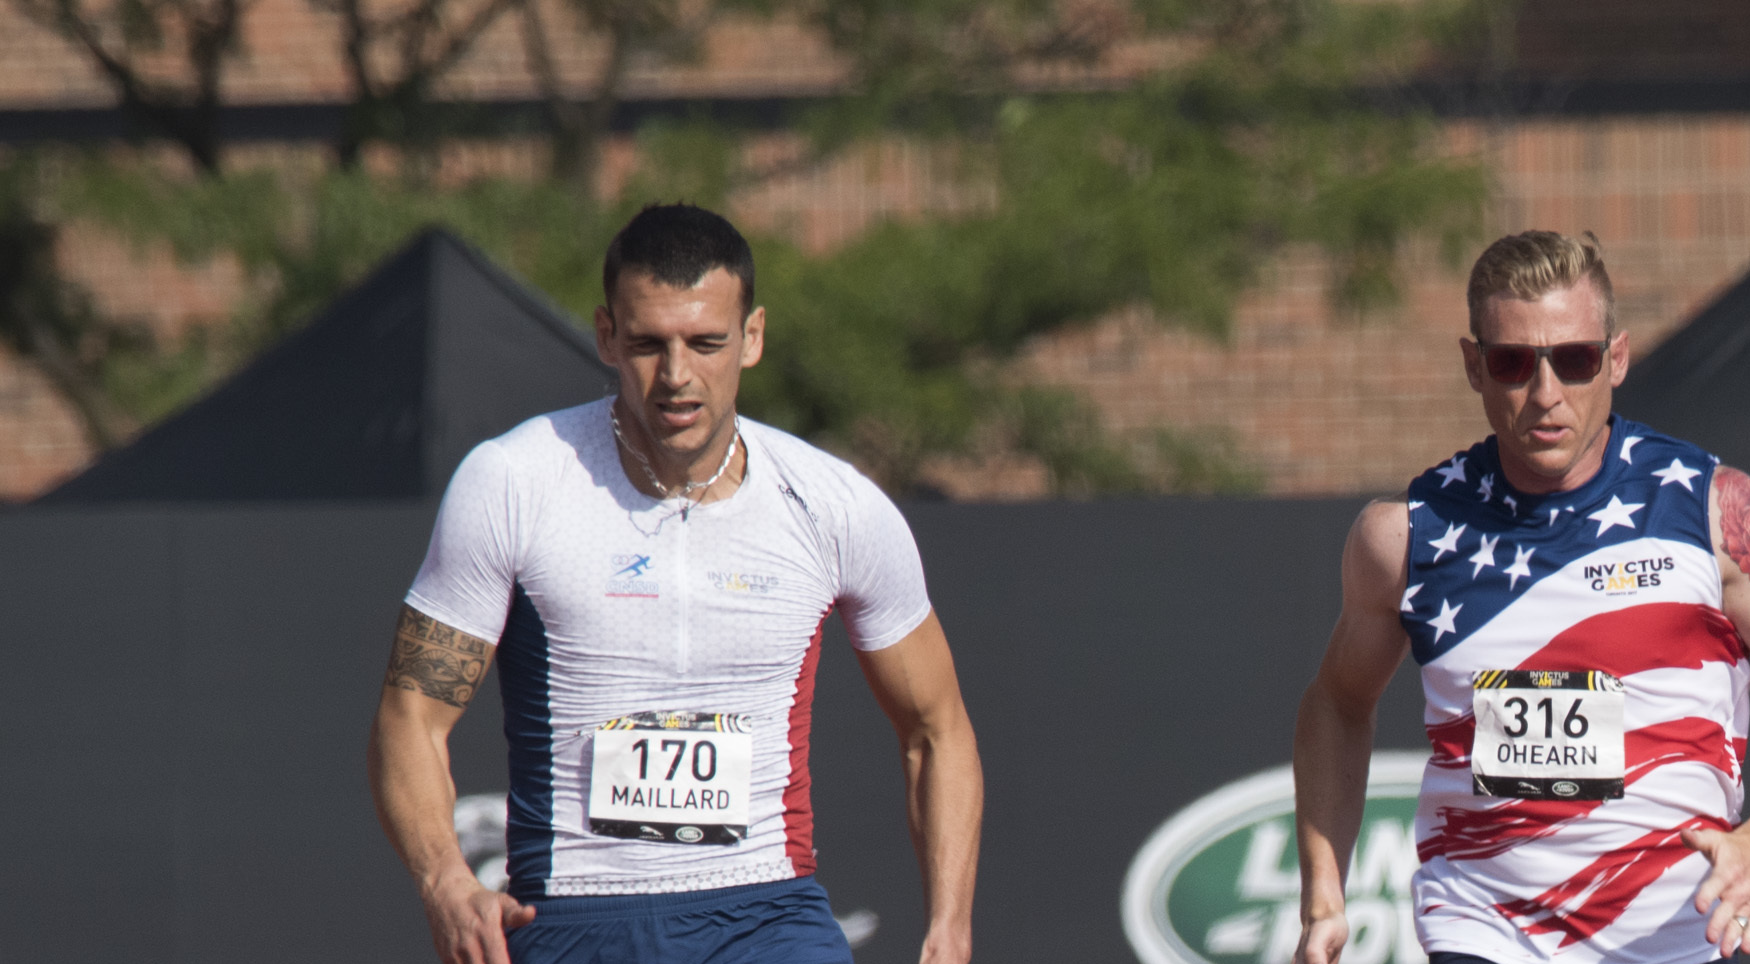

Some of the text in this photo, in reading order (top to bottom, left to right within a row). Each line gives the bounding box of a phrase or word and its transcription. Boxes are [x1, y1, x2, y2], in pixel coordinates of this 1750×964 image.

[1584, 557, 1675, 579] INVICTUS
[708, 571, 779, 586] INVICTUS
[714, 580, 769, 594] GAMES
[1591, 573, 1662, 591] GAMES
[1530, 671, 1569, 680] INVICTUS
[1532, 678, 1563, 687] GAMES
[1503, 696, 1589, 740] 316
[632, 738, 717, 782] 170
[1497, 743, 1598, 766] OHEARN
[611, 785, 730, 810] MAILLARD
